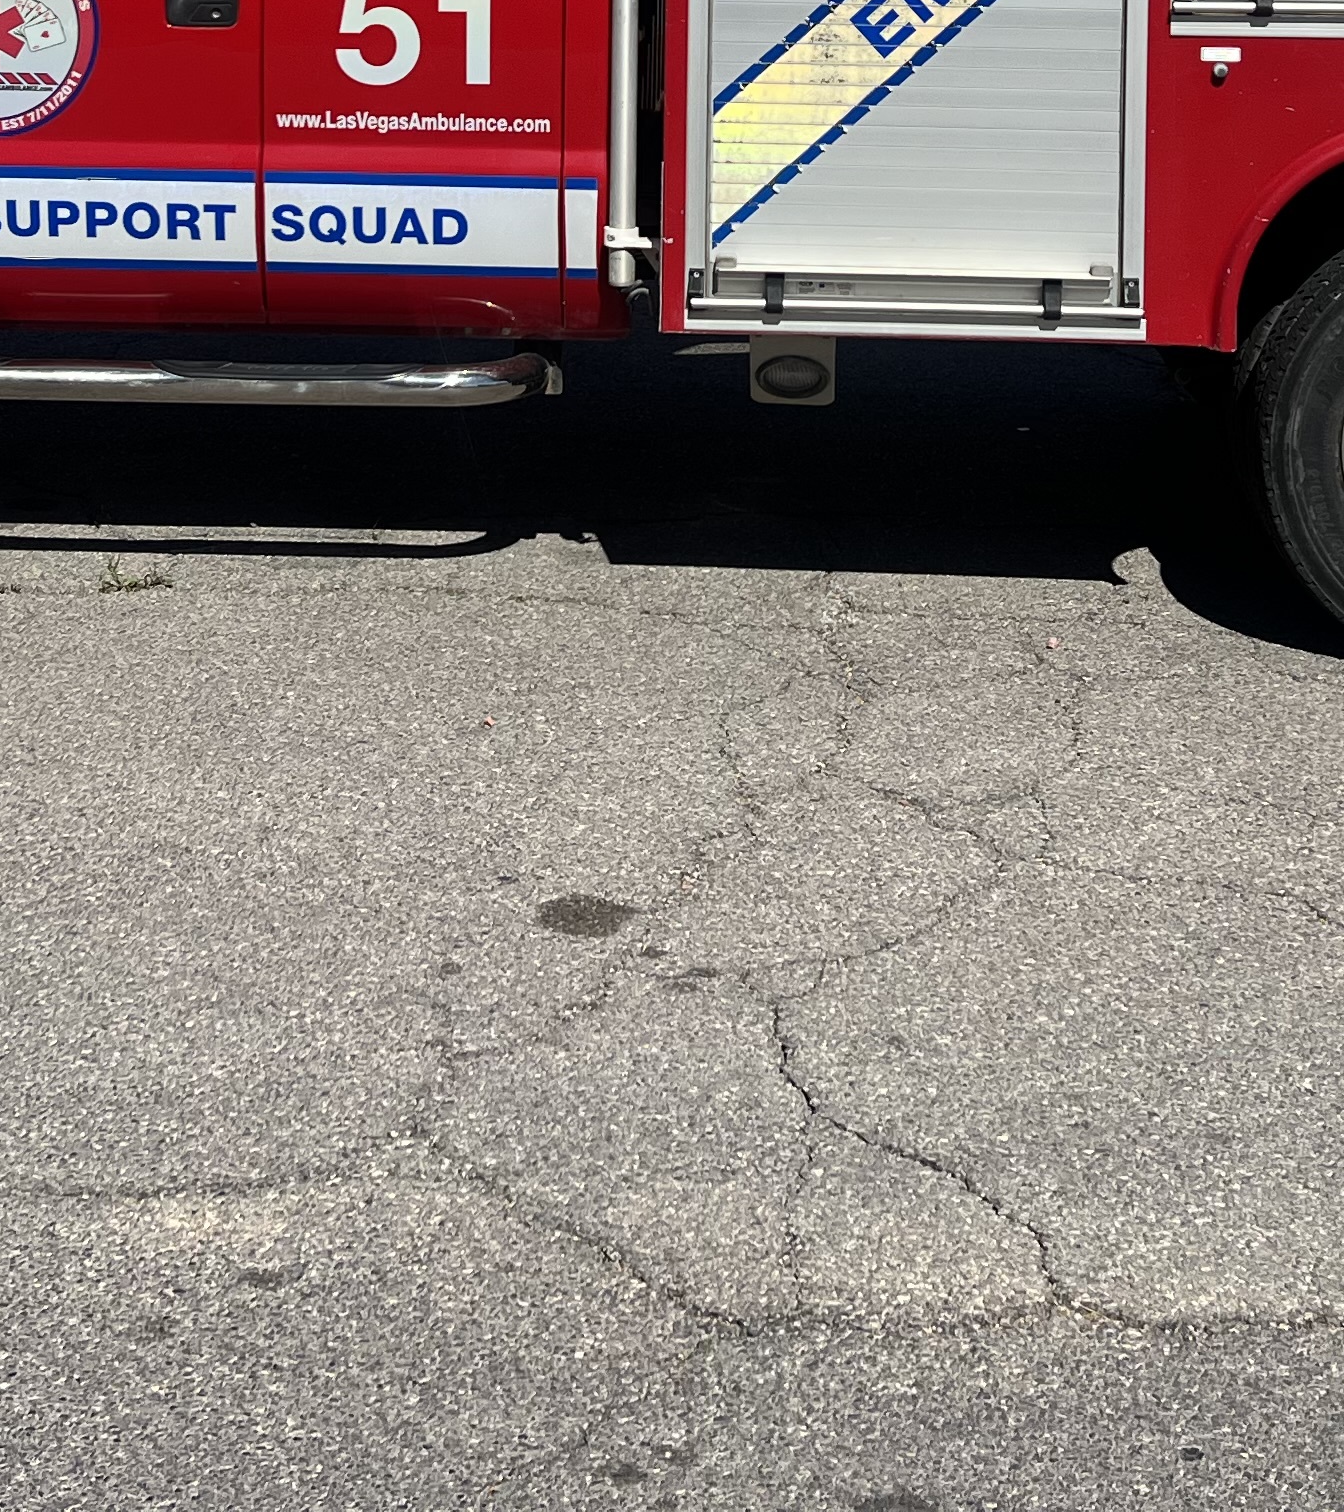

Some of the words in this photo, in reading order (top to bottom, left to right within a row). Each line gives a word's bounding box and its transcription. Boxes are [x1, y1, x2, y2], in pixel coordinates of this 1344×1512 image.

[1, 115, 25, 131] EST
[26, 71, 82, 124] 7/11/2011
[276, 110, 551, 134] www.LasVegasAmbulance.com
[272, 203, 469, 245] SQUAD
